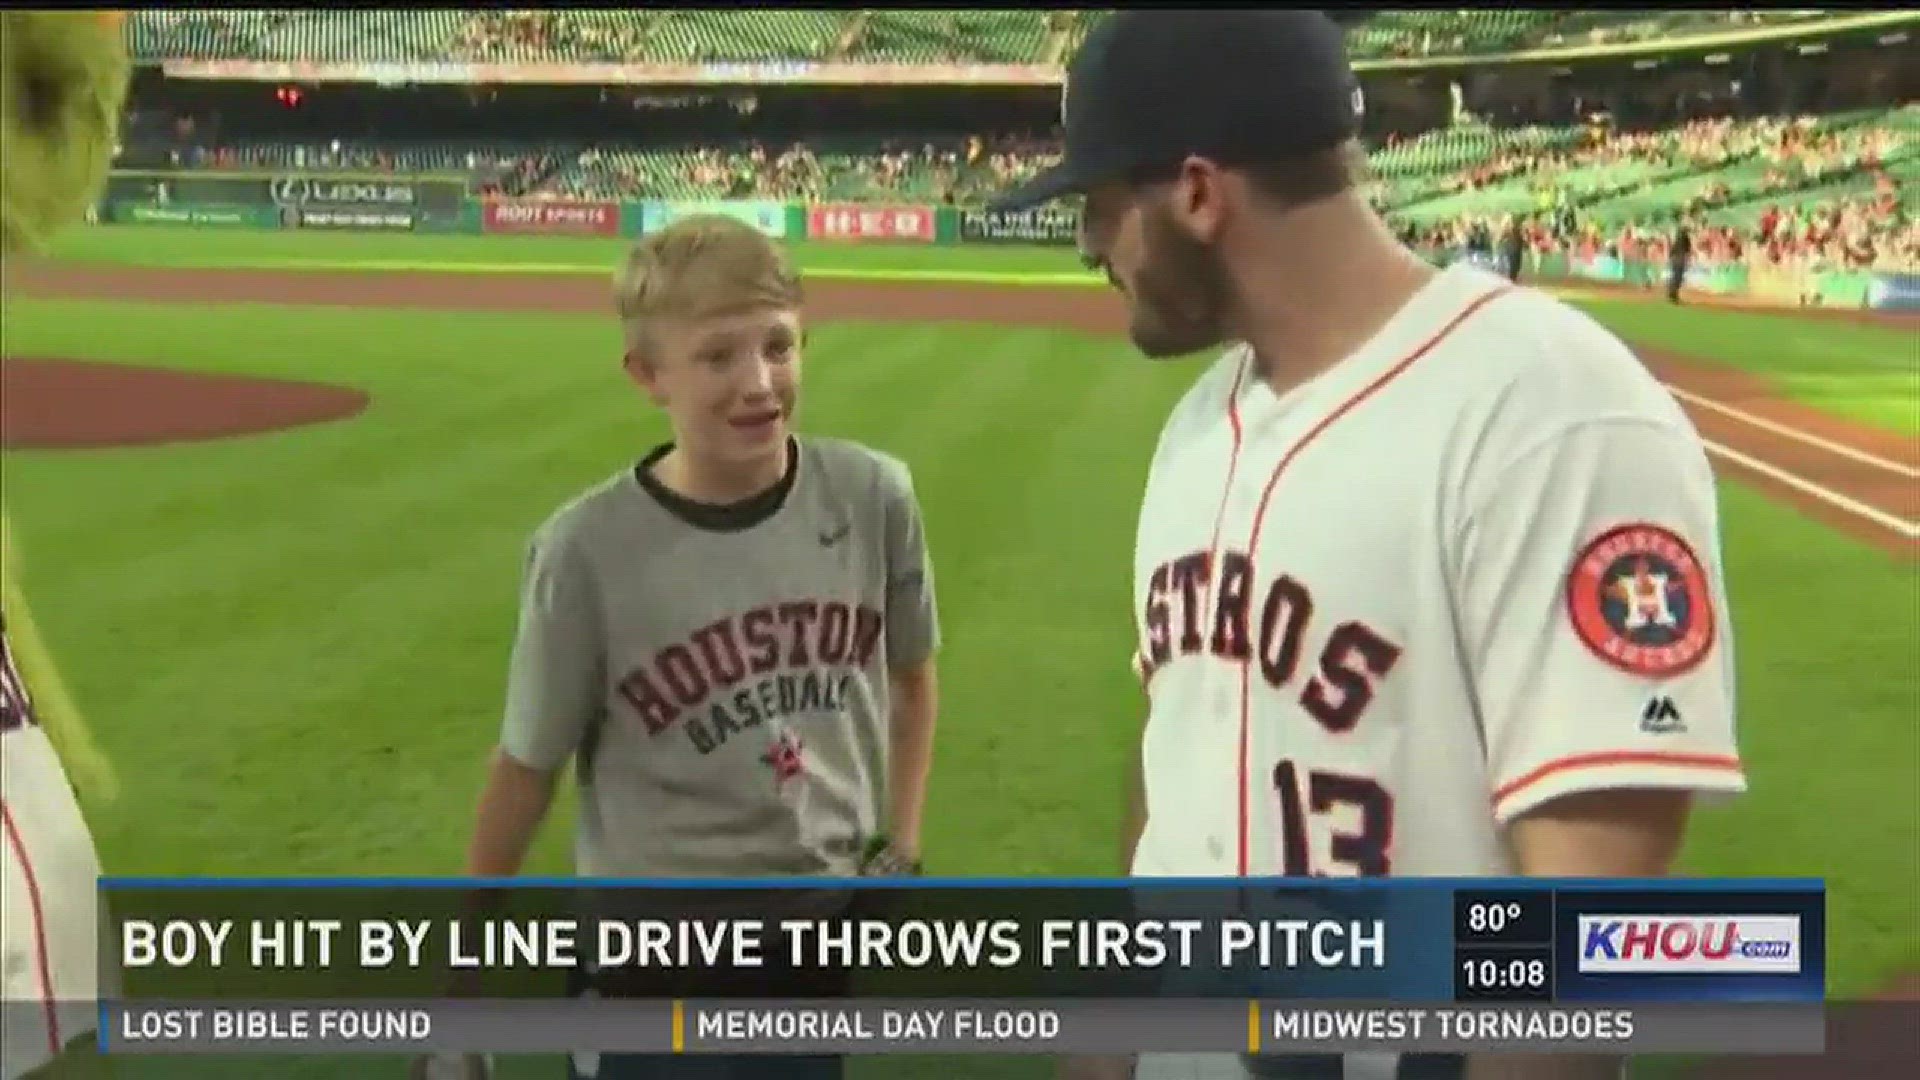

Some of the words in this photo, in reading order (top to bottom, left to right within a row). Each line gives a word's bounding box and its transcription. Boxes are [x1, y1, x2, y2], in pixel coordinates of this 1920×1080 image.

[615, 602, 884, 737] HOUSTON
[1140, 548, 1402, 734] STROS
[1272, 758, 1394, 877] 13
